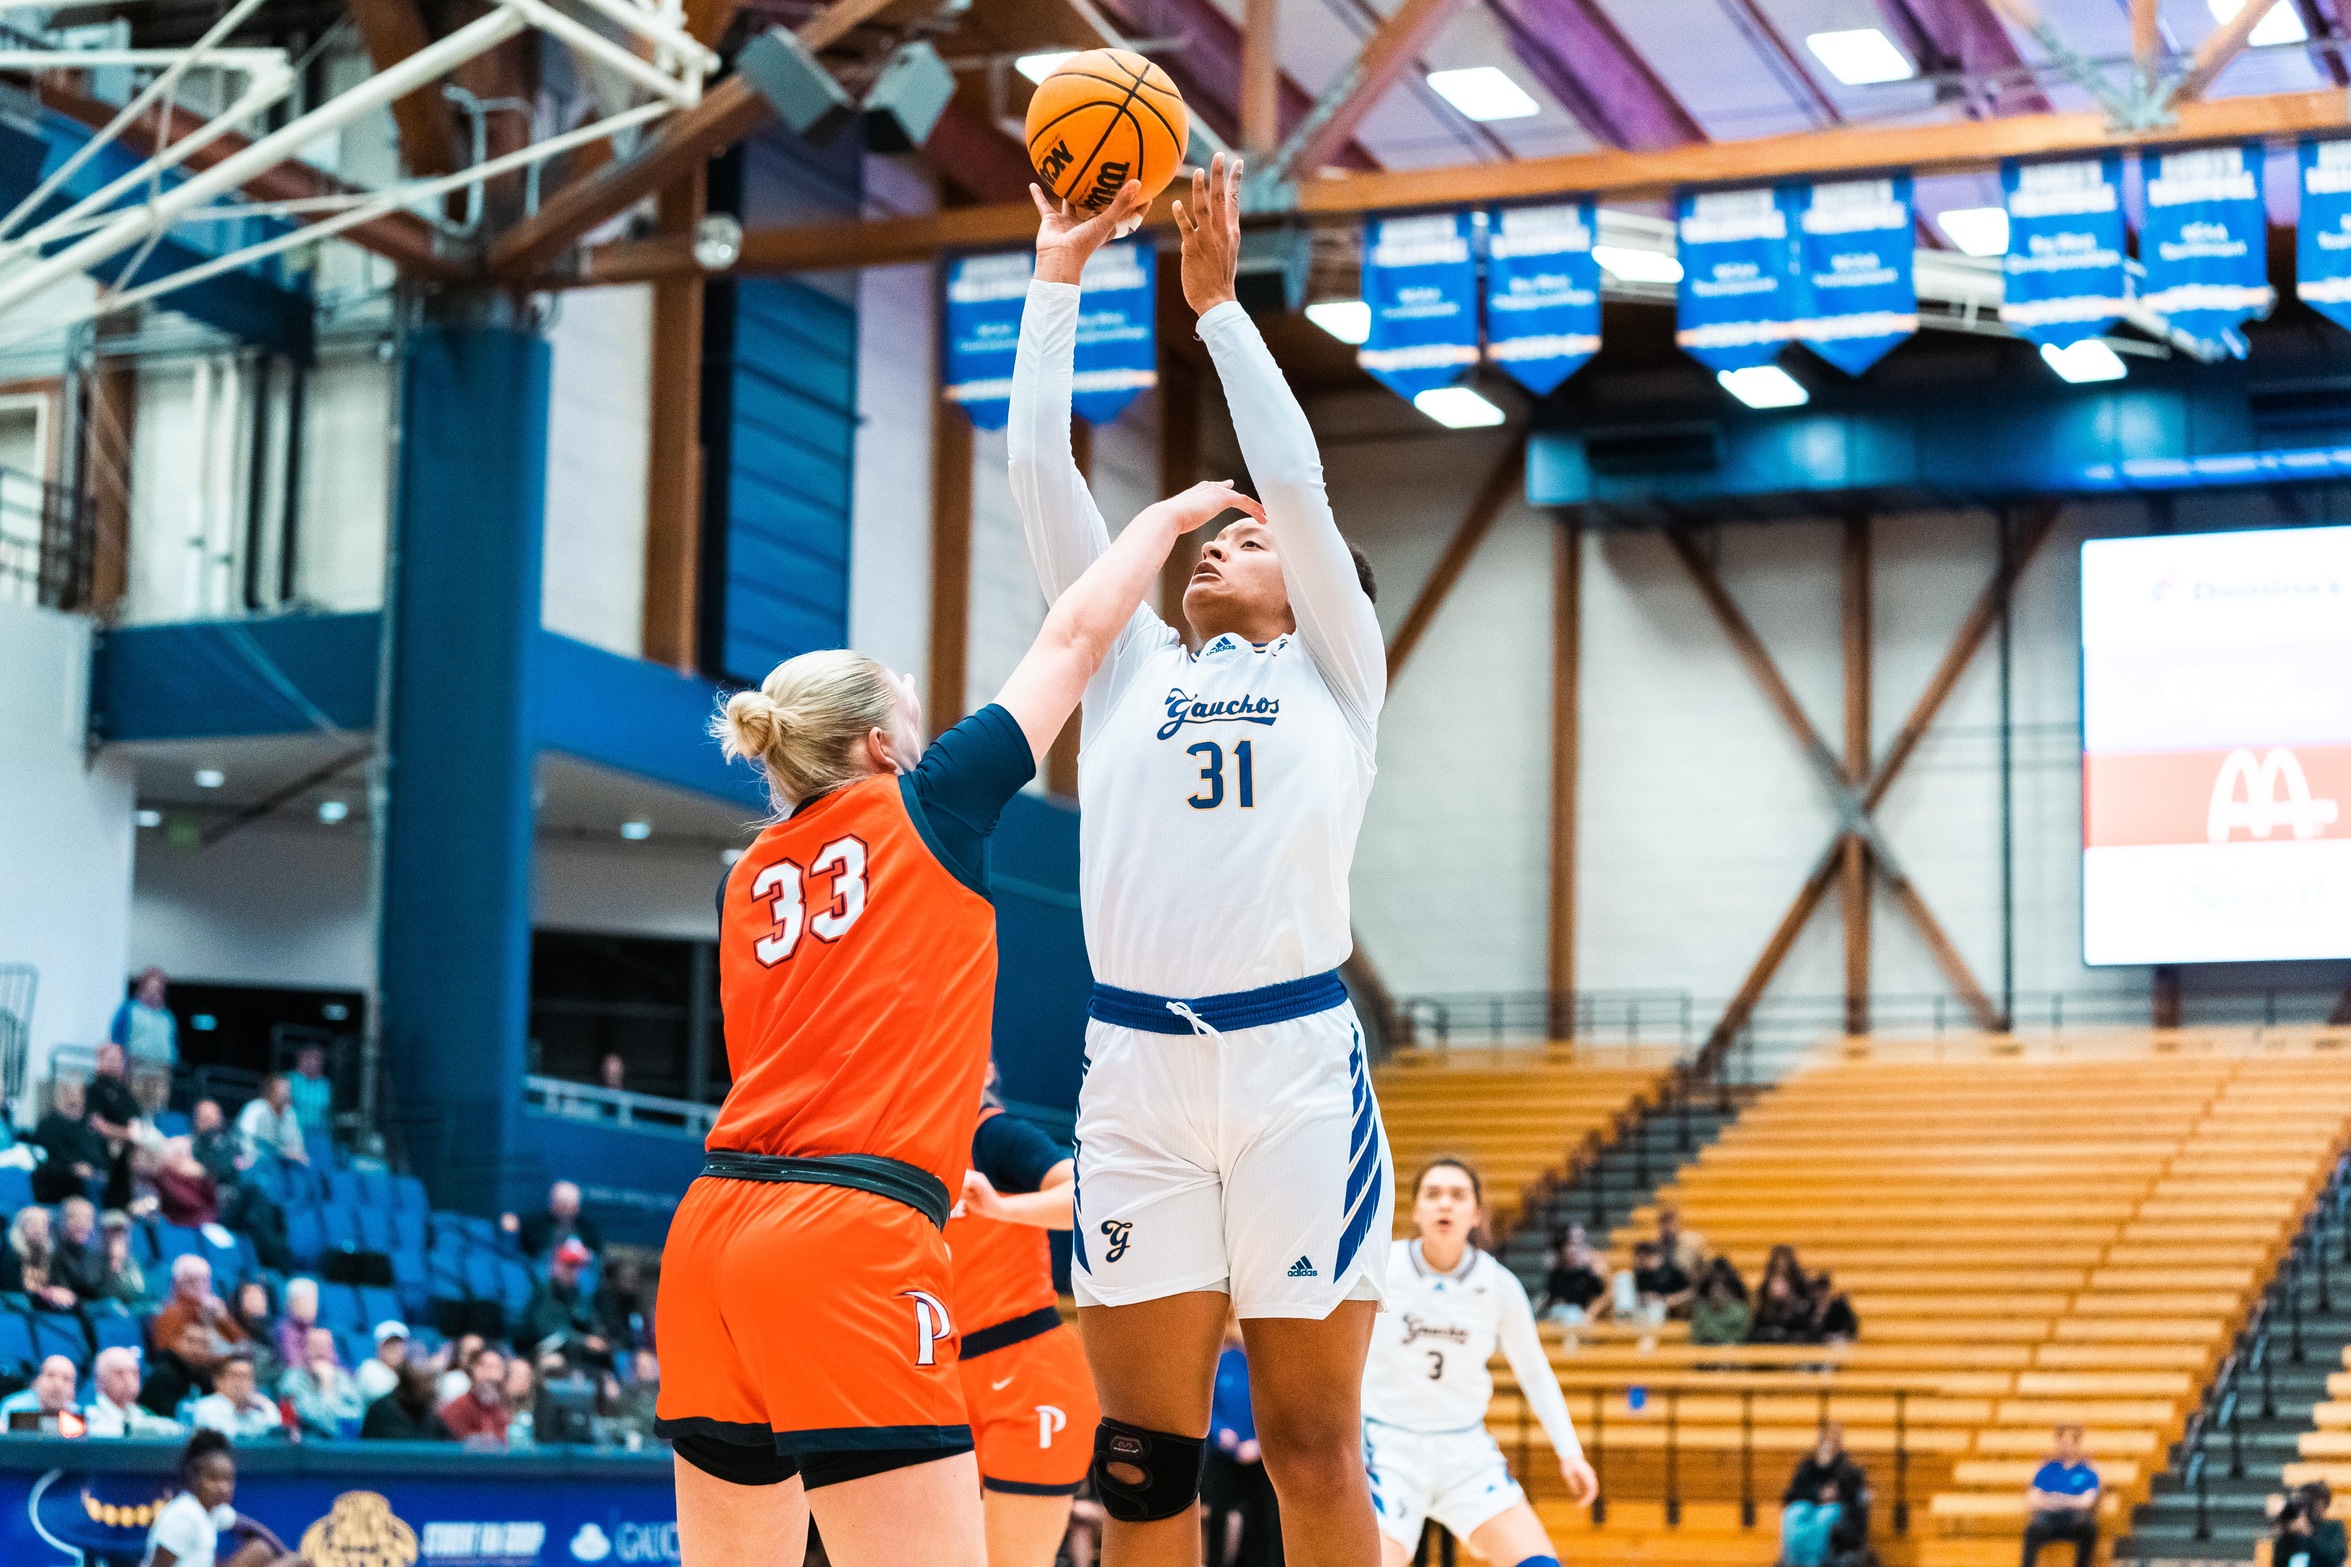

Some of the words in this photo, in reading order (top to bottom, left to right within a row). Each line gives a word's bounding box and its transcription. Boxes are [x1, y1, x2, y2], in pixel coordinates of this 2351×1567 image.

[1039, 139, 1075, 188] NCA
[1157, 687, 1280, 741] Gauchos
[1184, 738, 1256, 812] 31
[750, 833, 870, 970] 33
[1286, 1268, 1319, 1278] adidas
[1426, 1350, 1445, 1380] 3
